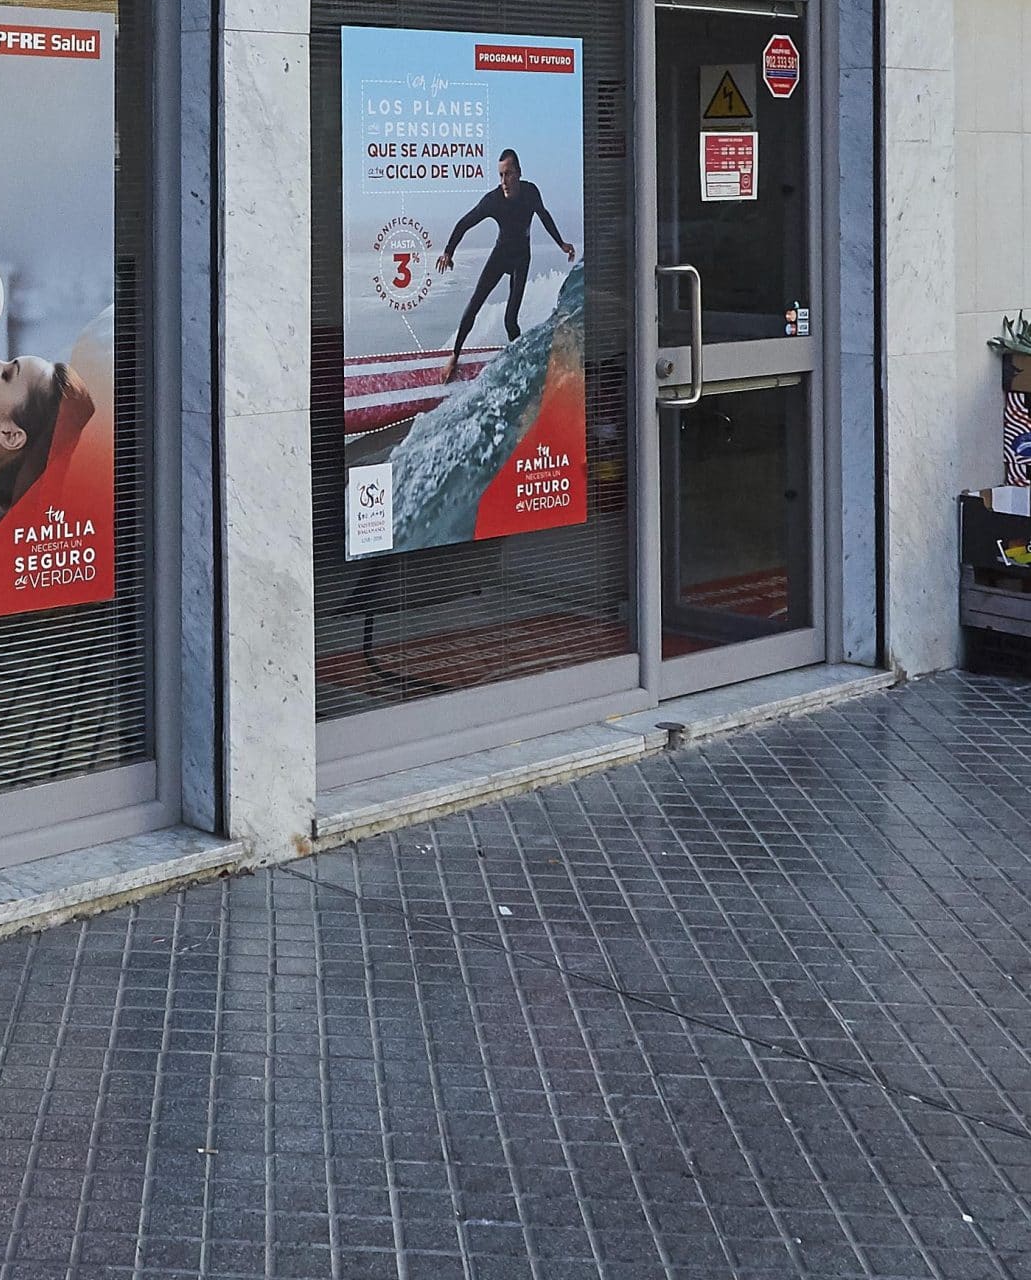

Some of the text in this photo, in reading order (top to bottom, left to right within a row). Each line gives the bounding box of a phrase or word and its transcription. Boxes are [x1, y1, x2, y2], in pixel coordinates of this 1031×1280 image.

[51, 34, 96, 52] Salud
[479, 53, 572, 65] PROGRAMA TU FUTURO
[368, 99, 483, 116] LOS PLANES
[385, 121, 484, 137] PENSIONES
[368, 143, 484, 158] QUE SE ADAPTAN
[386, 164, 427, 179] CICLO
[431, 164, 449, 178] DE
[452, 164, 484, 178] VIDA
[391, 240, 416, 249] HASTA
[373, 276, 432, 311] POR TRASLADO
[516, 454, 570, 473] FAMILIA
[525, 471, 551, 480] NECESITA
[517, 478, 570, 497] FUTURO
[525, 493, 570, 512] VERDAD
[45, 505, 65, 524] tu
[14, 520, 95, 544] FAMILIA
[31, 539, 83, 553] NECESITA UN
[14, 547, 95, 573] SEGURO
[29, 565, 96, 589] VERDAD
